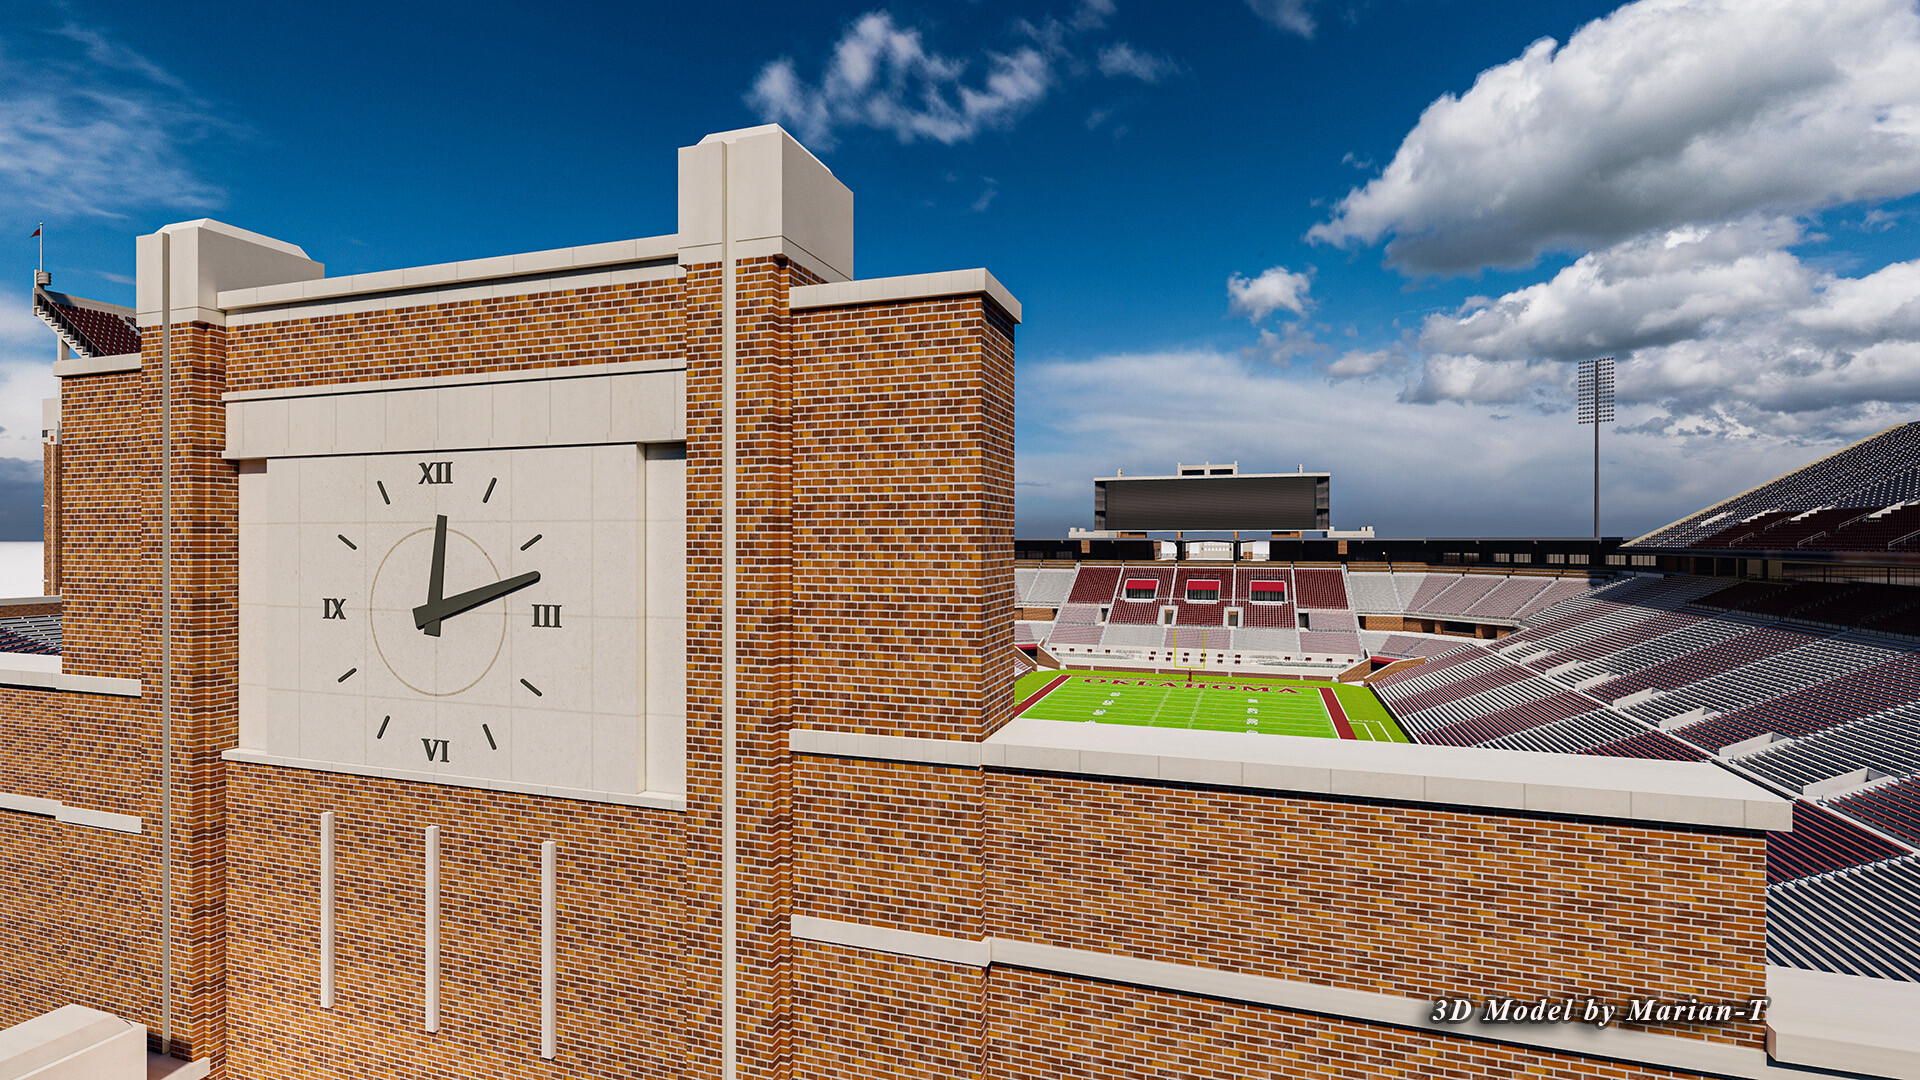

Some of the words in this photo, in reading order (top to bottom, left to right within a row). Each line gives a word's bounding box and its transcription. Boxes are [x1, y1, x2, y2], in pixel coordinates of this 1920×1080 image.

[418, 461, 453, 485] XII
[322, 597, 347, 620] IX
[531, 604, 563, 629] III
[1083, 678, 1302, 694] OKLAHOMA
[421, 738, 450, 763] VI
